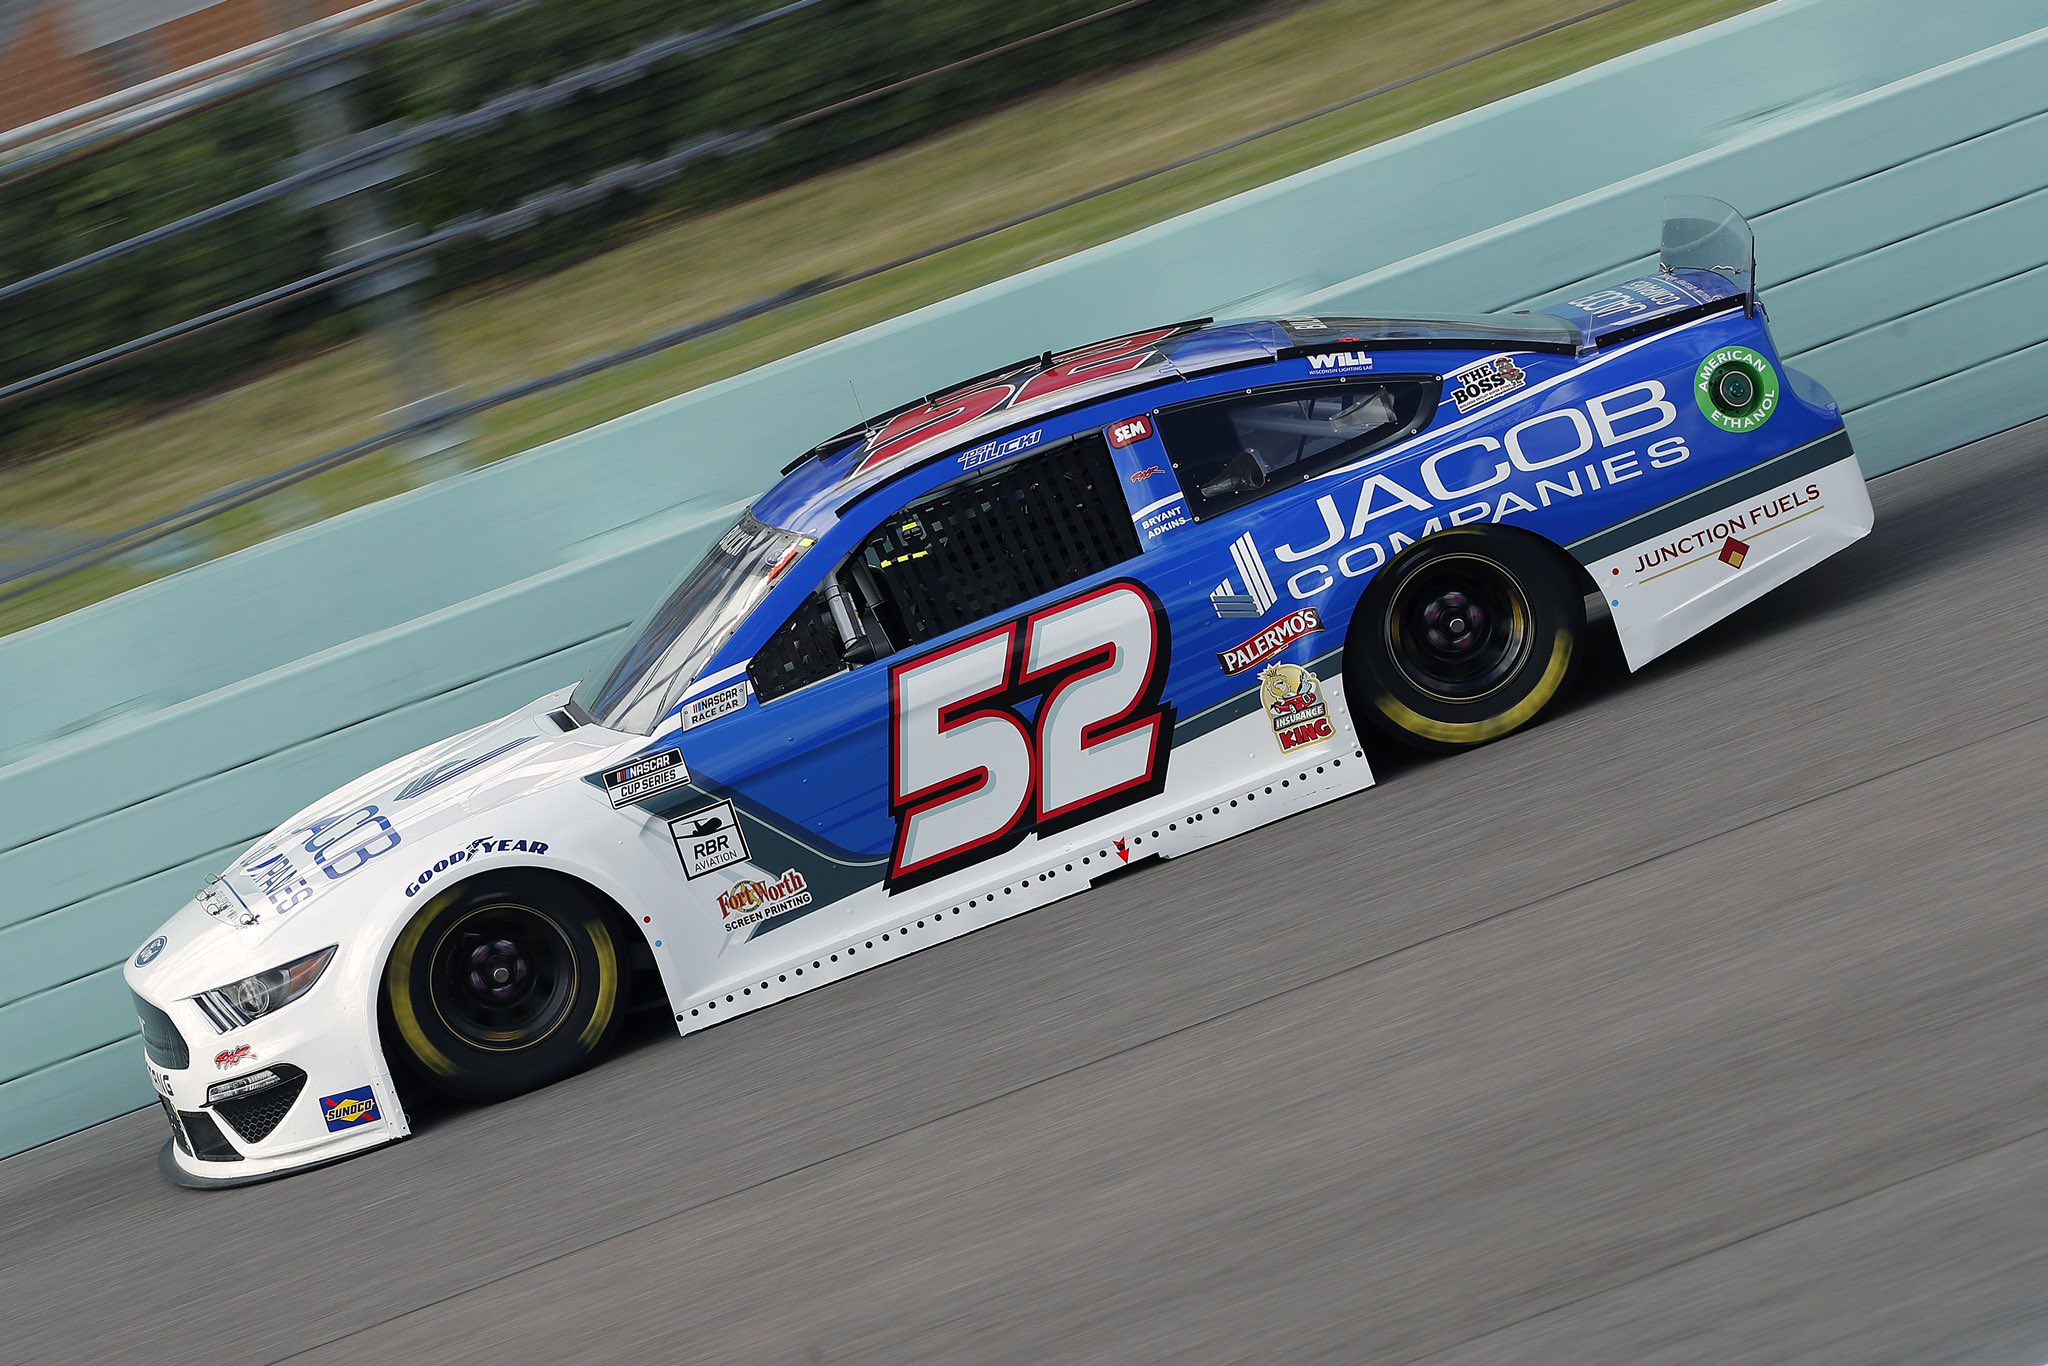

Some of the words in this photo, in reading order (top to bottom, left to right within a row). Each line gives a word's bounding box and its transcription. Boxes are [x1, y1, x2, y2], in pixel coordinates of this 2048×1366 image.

[1338, 365, 1363, 373] LIGHTING
[1459, 365, 1492, 386] THE
[1698, 350, 1767, 392] AMERICAN
[1452, 372, 1505, 405] BOSS
[1710, 389, 1775, 430] ETHANOL
[1114, 420, 1146, 443] SEM
[963, 429, 1043, 471] BILICKI
[1274, 379, 1678, 563] JACOB
[1141, 506, 1182, 530] BRYANT
[1147, 517, 1187, 540] ADKINS
[1286, 436, 1691, 600] COMPANIES
[1635, 515, 1747, 573] JUNCTION
[1749, 484, 1820, 525] FUELS
[1223, 610, 1318, 672] PALERMO'S
[691, 708, 717, 725] RACE
[719, 700, 739, 713] CAR
[700, 687, 738, 711] NASCAR
[887, 582, 1163, 880] 52
[1275, 706, 1325, 729] INSURANCE
[1278, 718, 1332, 750] KING
[629, 755, 671, 778] NASCAR
[620, 782, 641, 798] CUP
[642, 769, 677, 790] SERIES
[290, 805, 402, 880] ACOB
[694, 835, 730, 860] RBR
[405, 836, 549, 898] GOODYEAR
[695, 850, 738, 873] AVIATION
[716, 880, 757, 920] Fort
[749, 871, 807, 906] Worth
[725, 911, 763, 932] SCREEN
[764, 893, 811, 918] PRINTING
[327, 1099, 376, 1122] SUNOCO
